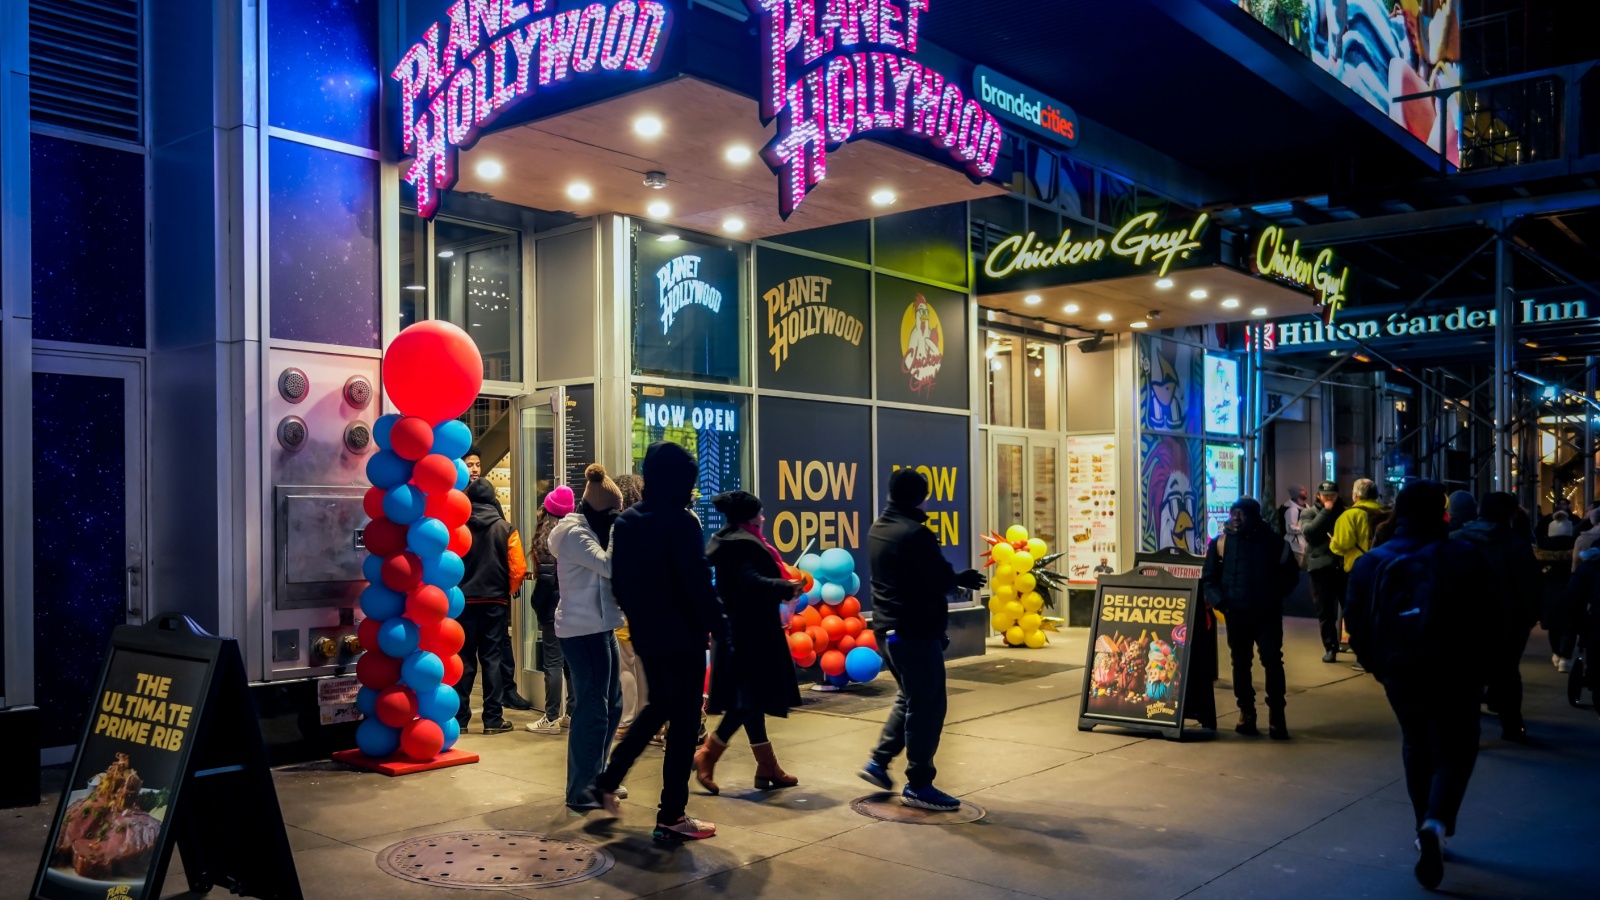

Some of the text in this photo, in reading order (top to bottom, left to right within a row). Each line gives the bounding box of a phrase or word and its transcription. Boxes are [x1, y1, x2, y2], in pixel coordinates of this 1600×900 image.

[391, 0, 546, 153] PLANE
[757, 0, 930, 118] PLANET
[404, 0, 667, 215] HOLLYWOOD
[774, 52, 1002, 211] HOLLYWOOD
[984, 212, 1208, 278] Chicken Guy!
[656, 255, 702, 302] PLANET
[1256, 226, 1349, 324] Chicken Guy!
[660, 280, 722, 335] HOLLYWOOD
[763, 275, 832, 338] PLANET
[1278, 320, 1382, 346] Hilton
[1520, 299, 1588, 324] Inn
[769, 305, 864, 372] HOLLYWOOD
[901, 347, 943, 373] Chicken
[645, 403, 735, 432] NOW OPEN
[778, 460, 857, 501] NOW
[892, 465, 957, 502] OW
[773, 511, 859, 553] OPEN
[921, 511, 959, 547] EN
[1101, 607, 1184, 625] SHAKES
[1103, 594, 1186, 610] DELICIOUS
[136, 672, 172, 699] THE
[102, 691, 193, 728] ULTIMATE
[94, 714, 184, 752] PRIME RIB
[107, 885, 132, 900] PLANET
